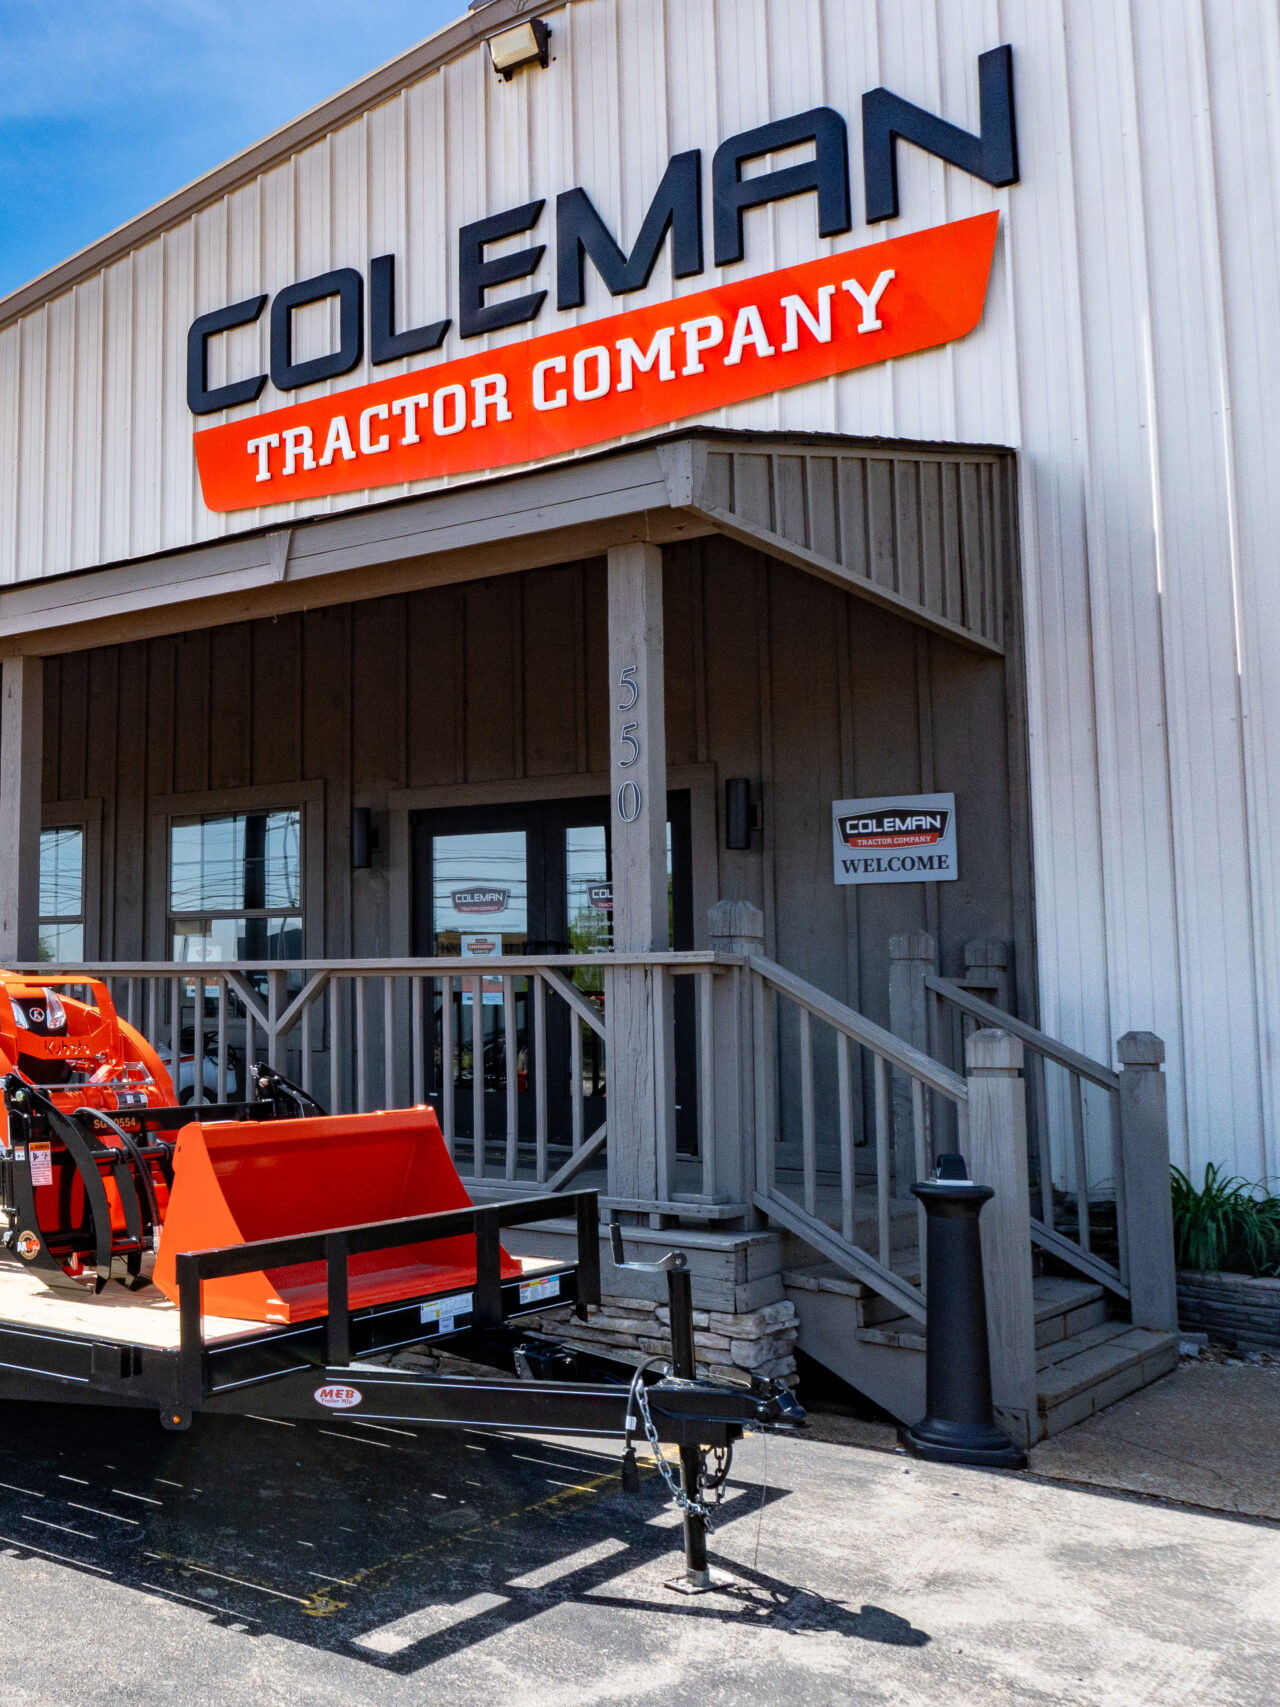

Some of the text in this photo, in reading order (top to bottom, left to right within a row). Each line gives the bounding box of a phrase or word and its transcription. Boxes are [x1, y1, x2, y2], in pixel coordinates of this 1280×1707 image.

[187, 44, 1020, 415] COLEMAN
[247, 269, 896, 482] TRACTOR COMPANY
[617, 665, 641, 823] 550
[846, 815, 941, 834] COLEMAN
[857, 835, 931, 846] TRACTOR COMPANY
[841, 854, 950, 874] WELCOME
[455, 893, 503, 902] COLEMAN
[44, 1040, 90, 1056] Kubota
[93, 1116, 136, 1129] SG0554
[320, 1388, 355, 1399] MEB
